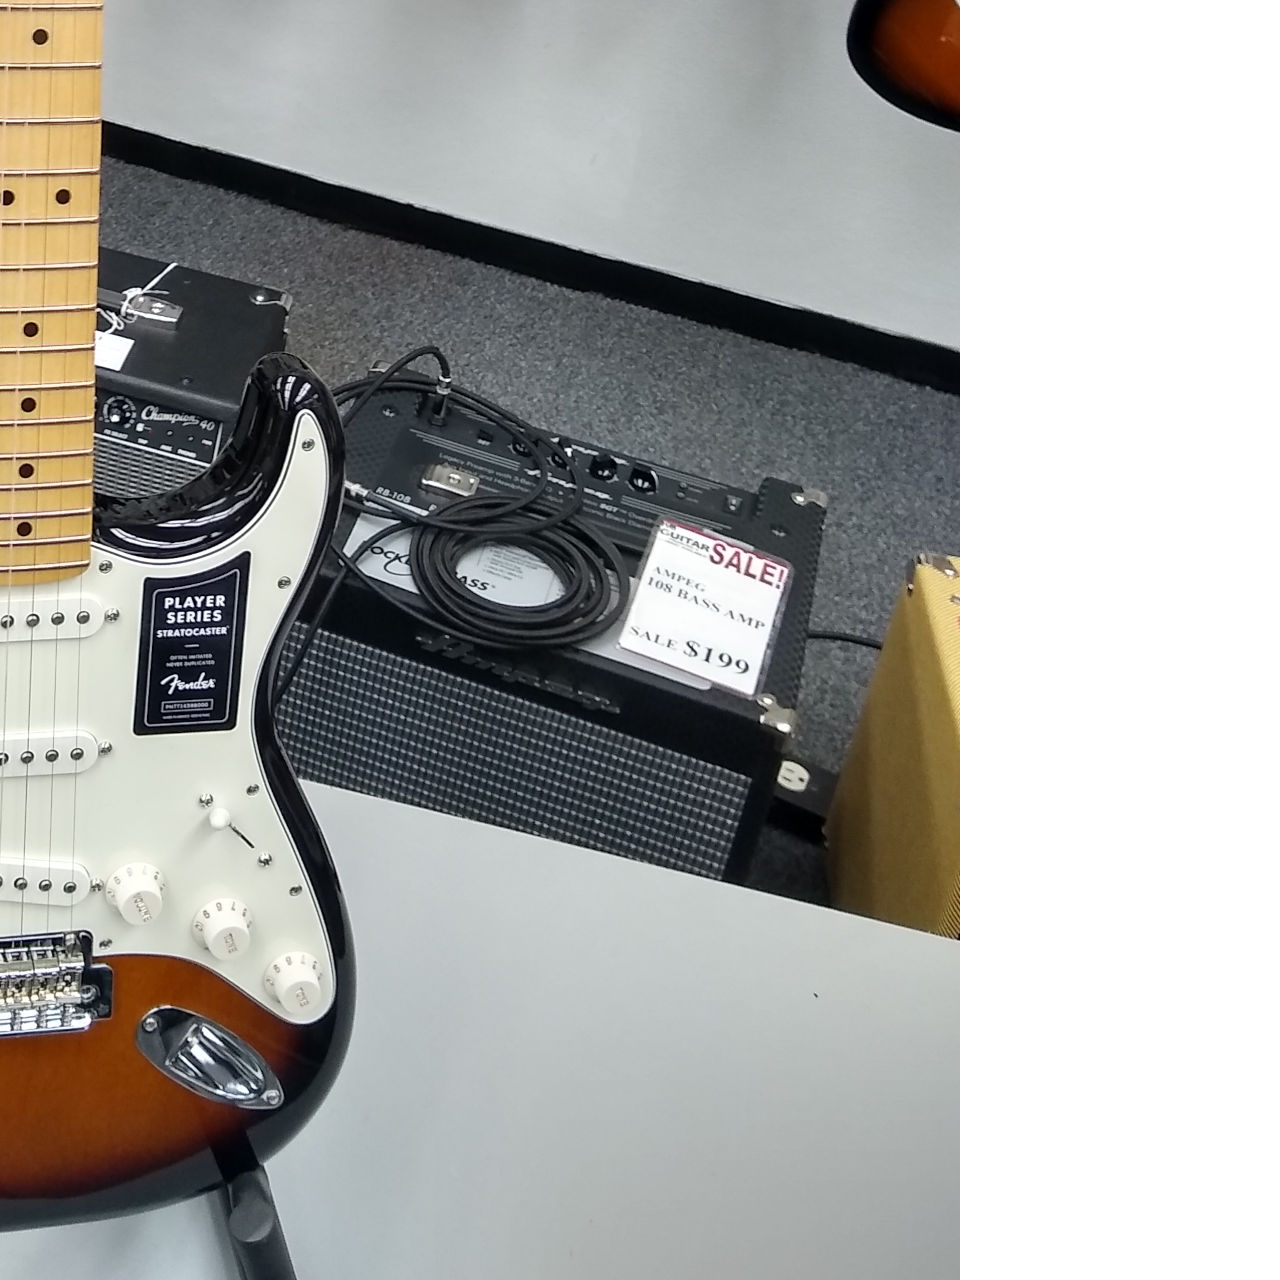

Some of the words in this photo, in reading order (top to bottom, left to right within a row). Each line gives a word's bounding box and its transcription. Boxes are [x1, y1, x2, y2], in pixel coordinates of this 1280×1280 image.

[141, 404, 200, 427] Champion
[199, 419, 216, 432] 40
[375, 486, 413, 505] RB-108
[660, 528, 710, 553] GUITAR
[709, 542, 785, 590] SALE!
[654, 566, 706, 593] AMPEG
[164, 594, 226, 609] PLAYER
[647, 576, 672, 594] 108
[677, 588, 721, 613] BASS
[723, 609, 766, 630] AMP
[166, 609, 222, 624] SERIES
[156, 626, 228, 638] STRATOCASTER
[630, 626, 678, 651] SALE
[683, 640, 750, 676] $199
[160, 672, 216, 696] Fender
